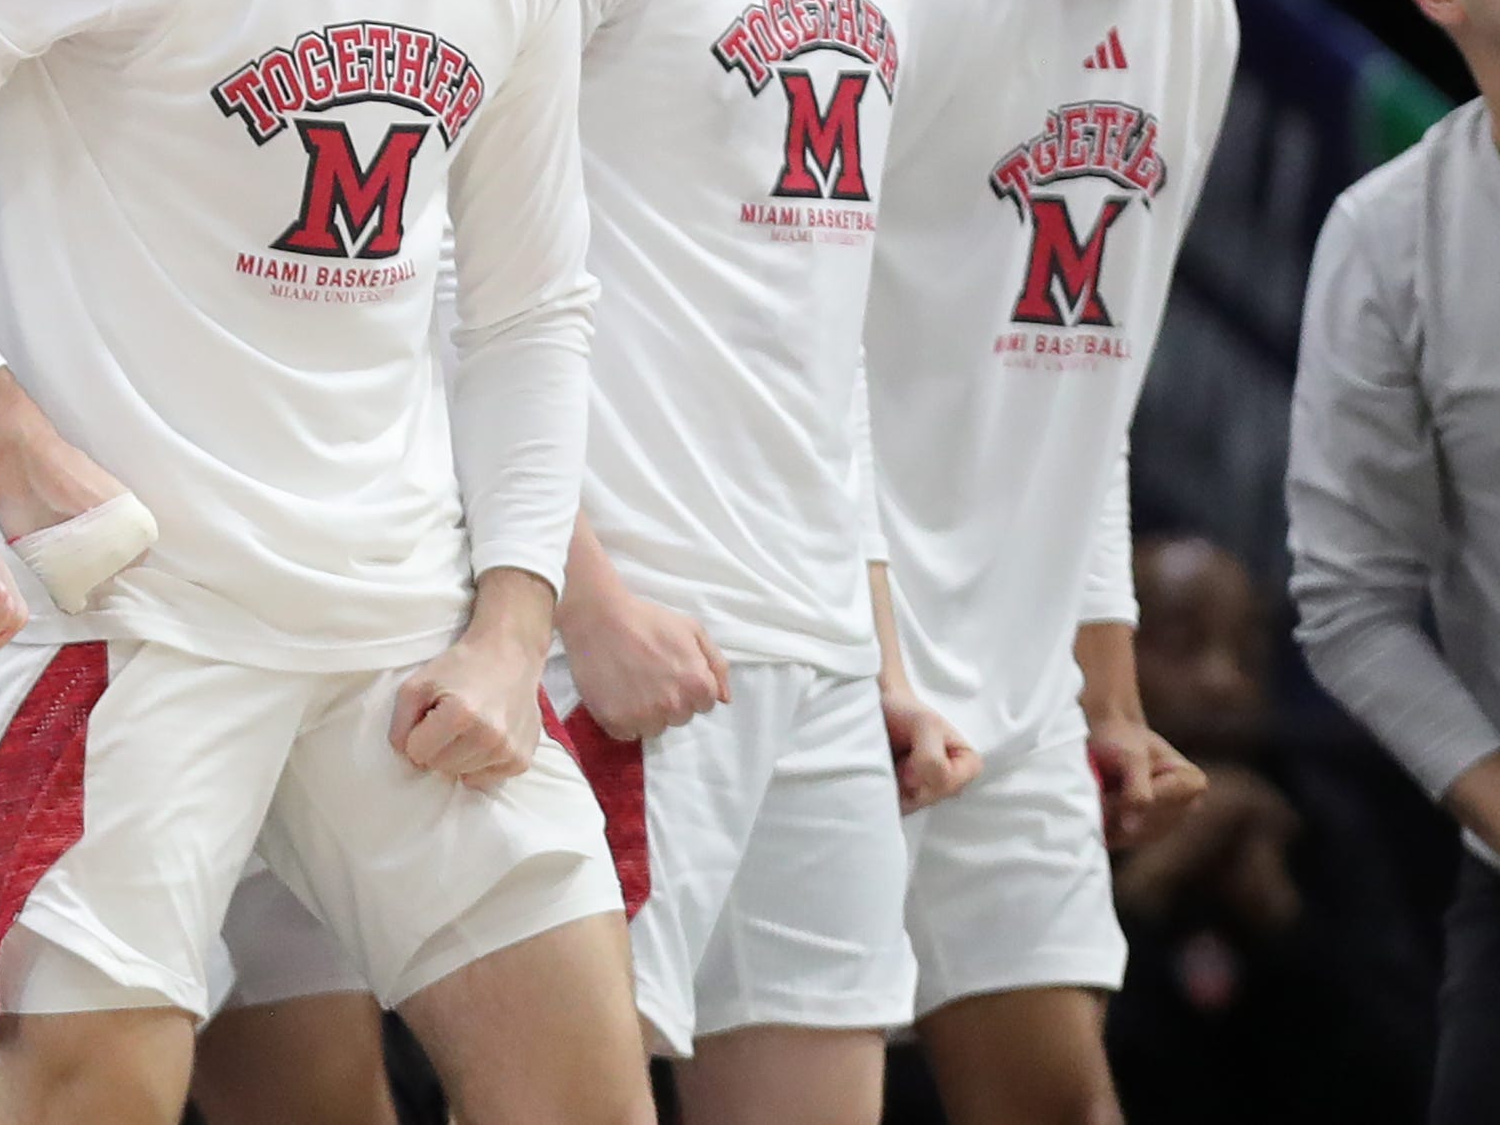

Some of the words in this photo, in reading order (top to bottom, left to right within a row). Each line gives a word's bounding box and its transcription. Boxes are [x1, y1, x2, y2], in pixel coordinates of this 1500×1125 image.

[210, 19, 485, 152] TOGETHER
[770, 67, 871, 202] M
[268, 117, 434, 259] M
[740, 203, 801, 227] MIAMI
[236, 252, 308, 285] MIAMI
[315, 258, 416, 288] BASKETBALL
[268, 283, 320, 302] MIAMI
[1010, 194, 1128, 327] M
